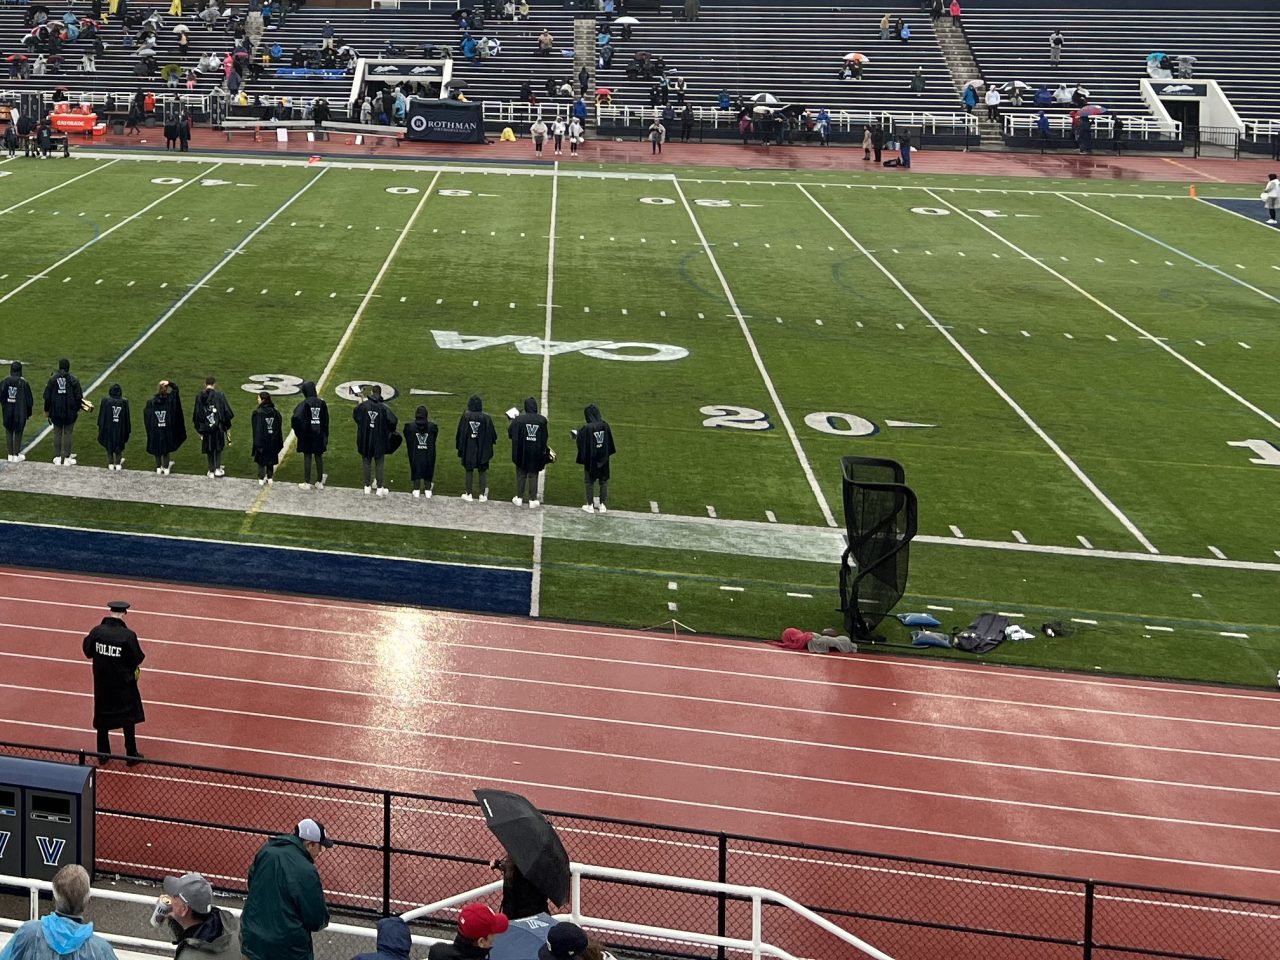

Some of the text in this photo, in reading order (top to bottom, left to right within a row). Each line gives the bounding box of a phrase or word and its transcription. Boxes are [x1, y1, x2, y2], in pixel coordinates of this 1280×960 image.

[428, 121, 477, 130] ROTHMAN
[95, 642, 122, 657] POLICE
[35, 836, 66, 866] V
